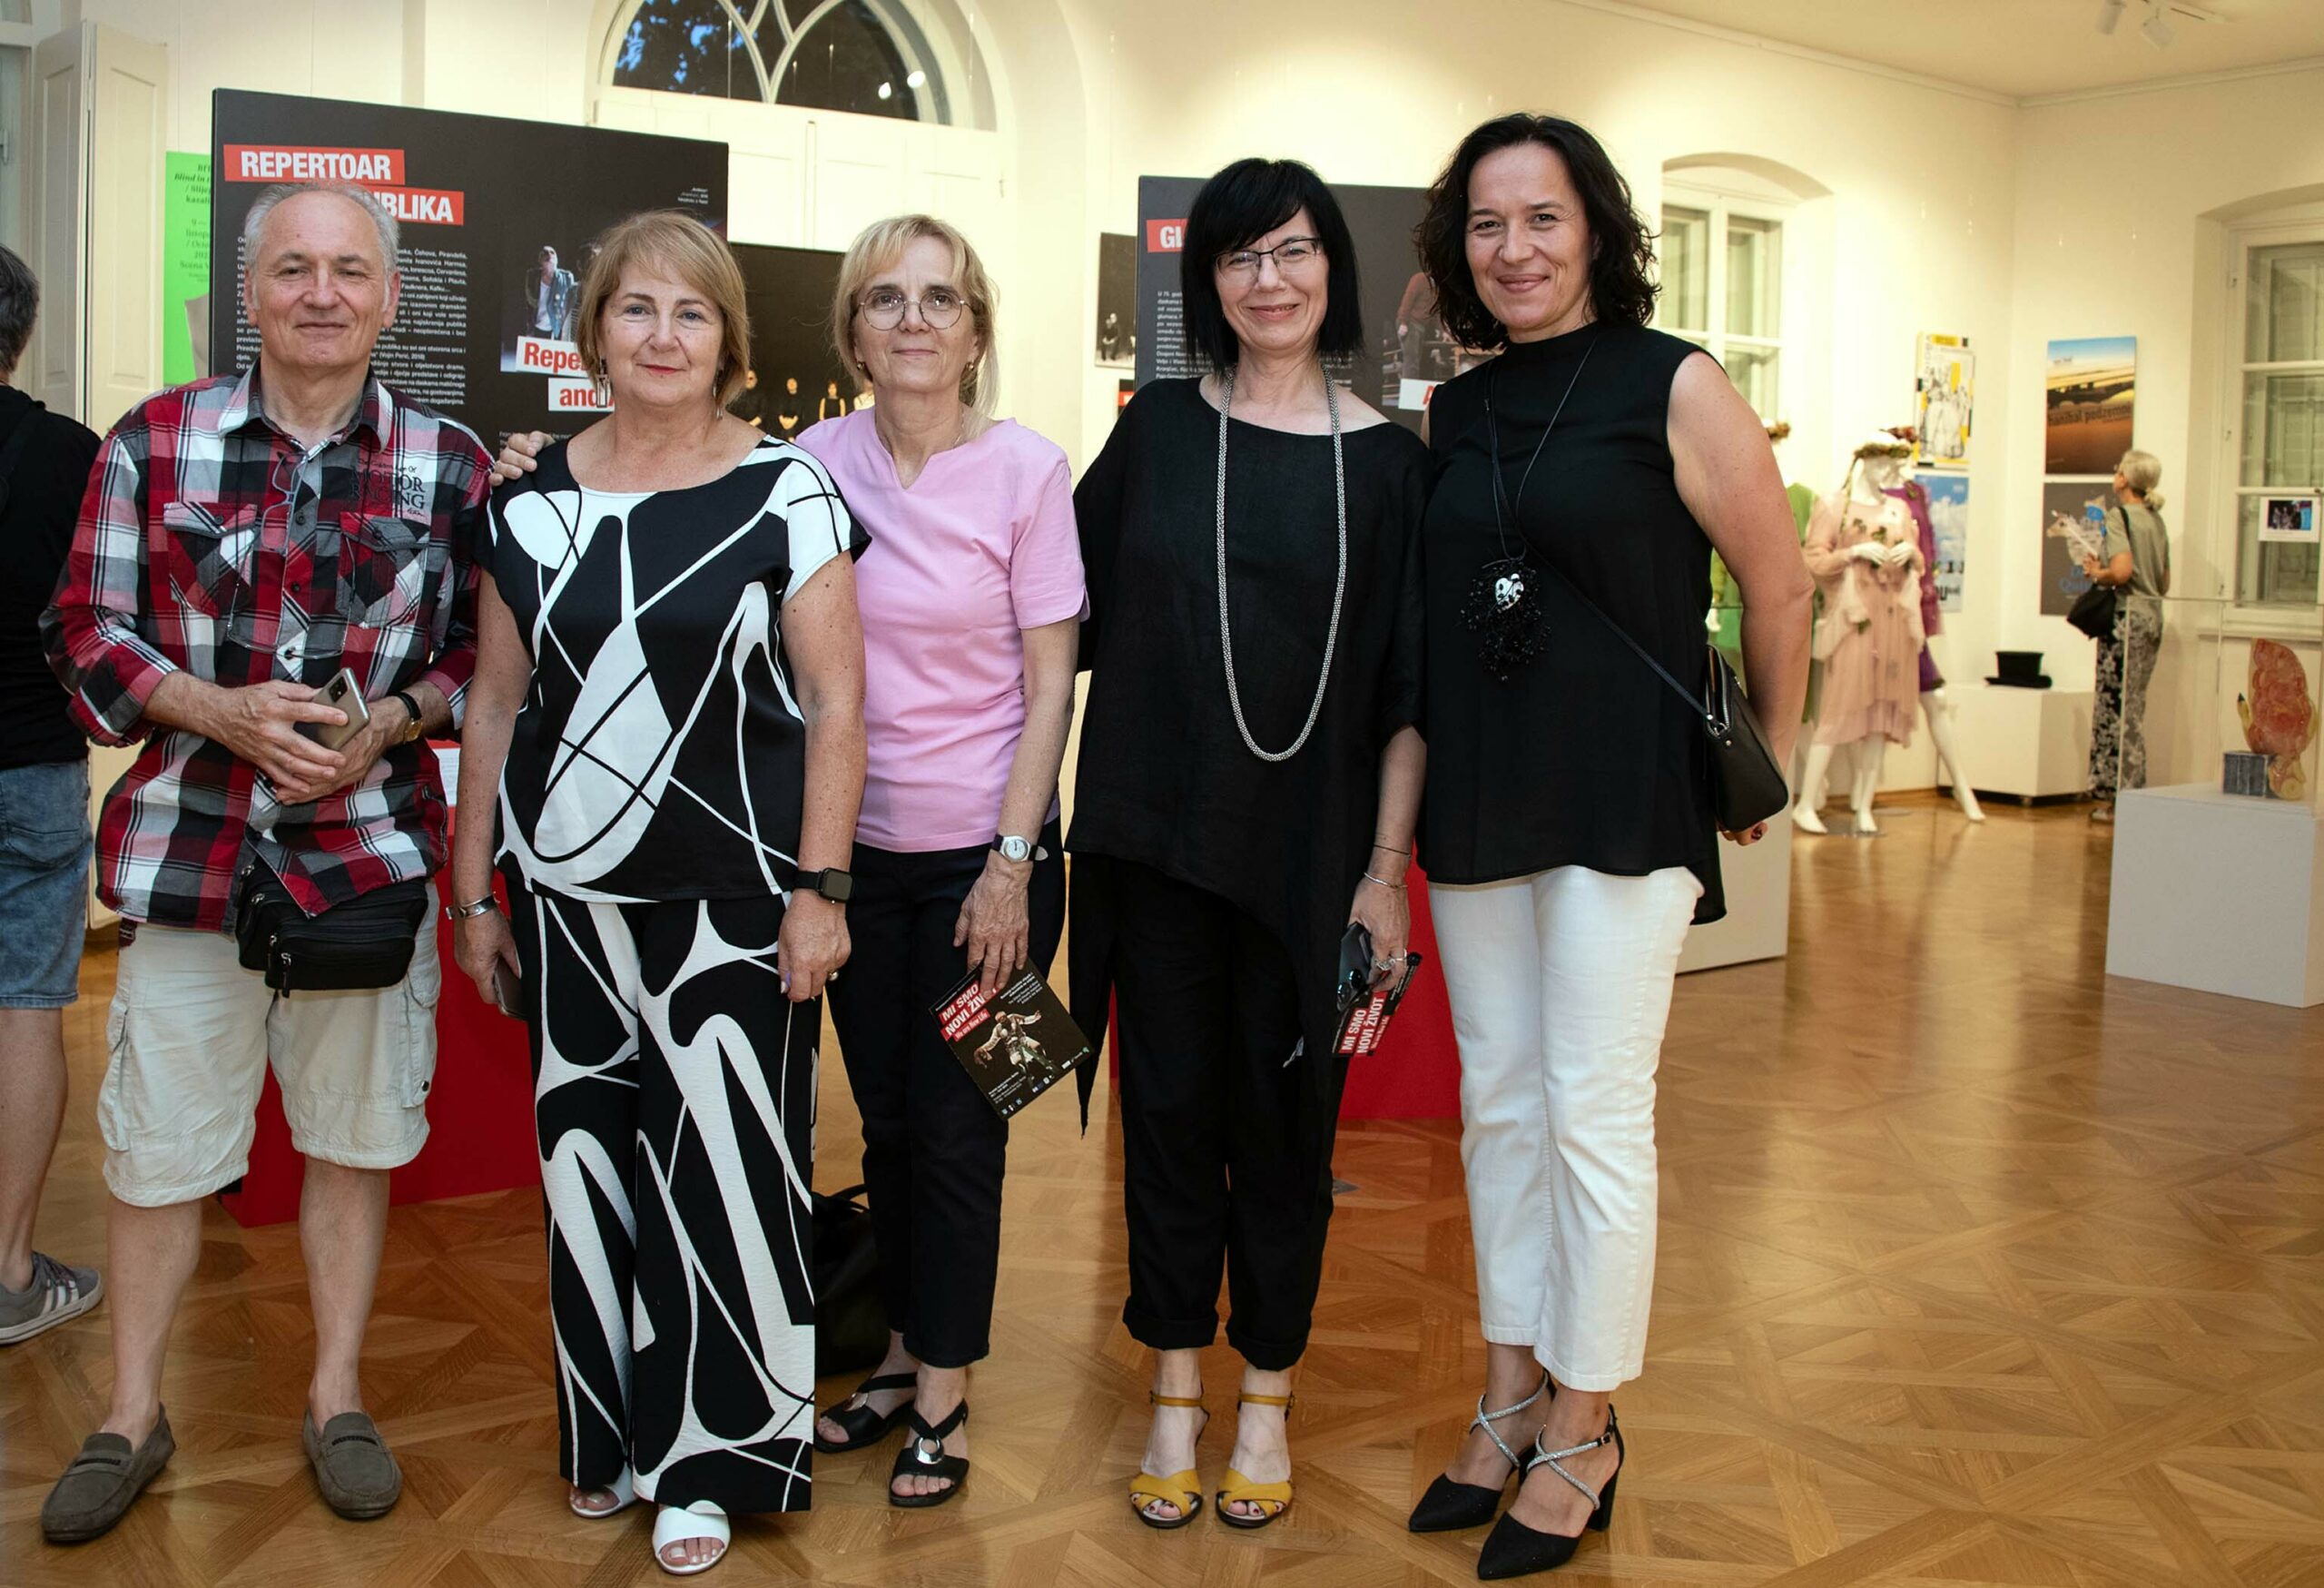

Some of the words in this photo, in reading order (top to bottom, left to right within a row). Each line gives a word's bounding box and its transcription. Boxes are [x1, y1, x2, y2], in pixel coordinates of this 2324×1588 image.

[241, 151, 391, 181] REPERTOAR
[376, 192, 454, 223] BLIKA
[524, 341, 583, 375] Repe
[942, 1006, 955, 1021] MI
[956, 983, 979, 1008] SMO
[1364, 997, 1384, 1027] ŽIVOT
[944, 1012, 970, 1036] NOVI
[1348, 1009, 1366, 1034] SMO
[1341, 1036, 1357, 1050] MI
[1356, 1028, 1375, 1054] NOVI
